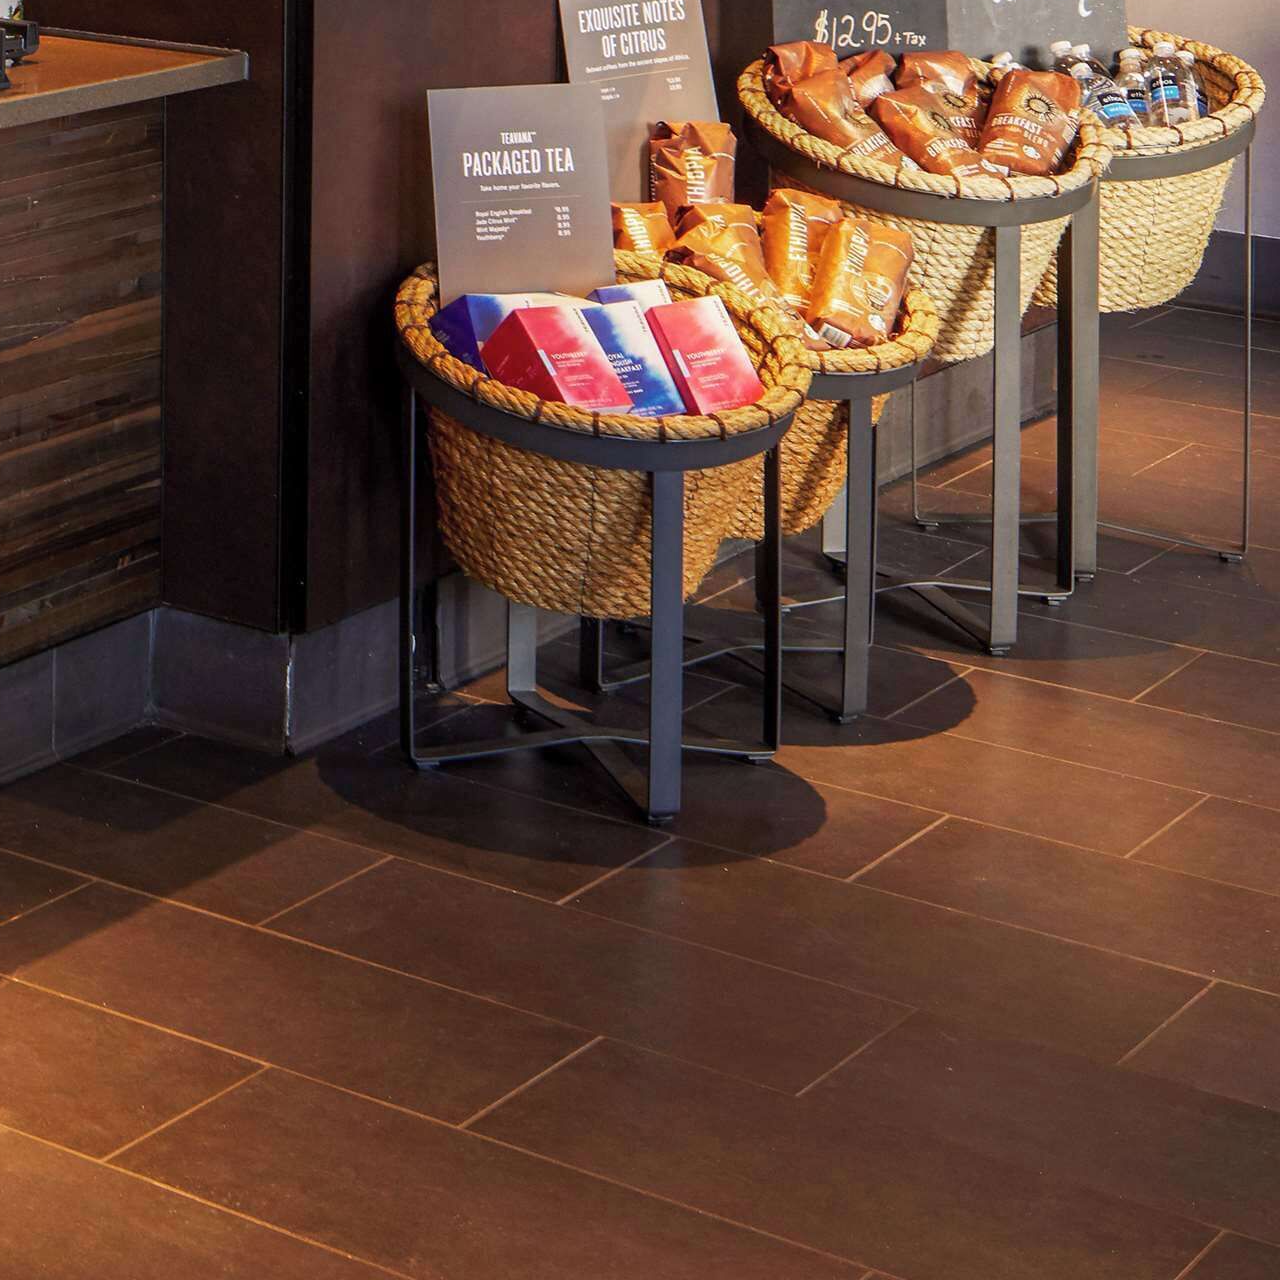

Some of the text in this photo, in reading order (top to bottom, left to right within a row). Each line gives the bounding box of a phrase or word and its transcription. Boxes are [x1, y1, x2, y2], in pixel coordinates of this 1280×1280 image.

[578, 4, 641, 33] EXQUISITE
[601, 29, 667, 58] OF CITRUS
[903, 31, 927, 46] Tax
[463, 147, 575, 177] PACKAGED TEA
